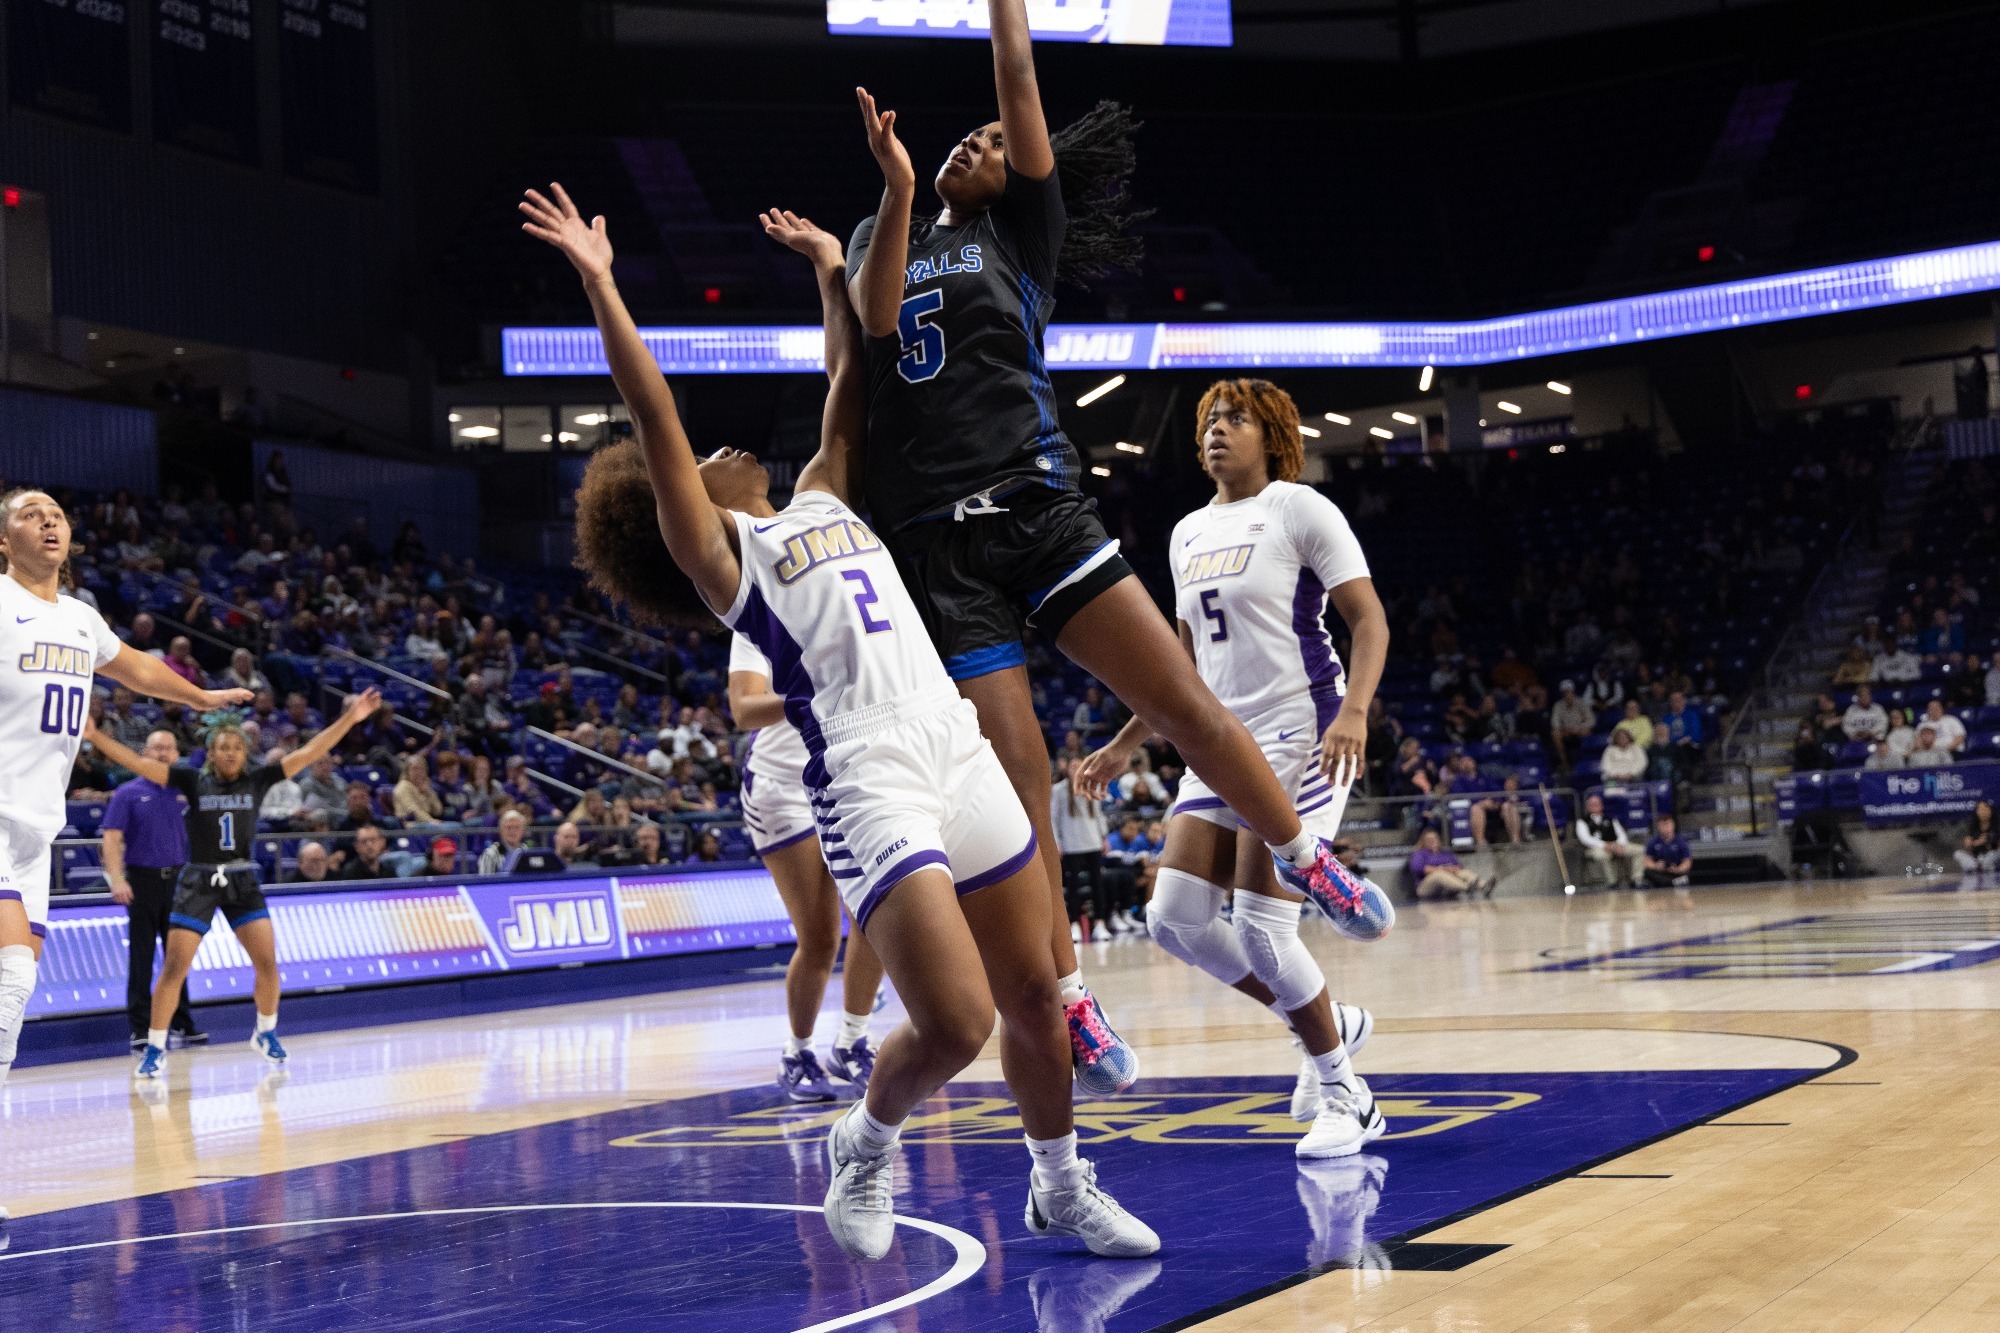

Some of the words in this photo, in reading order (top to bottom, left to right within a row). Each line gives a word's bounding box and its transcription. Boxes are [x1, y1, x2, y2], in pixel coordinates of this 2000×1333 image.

[905, 244, 983, 289] YALS
[896, 288, 946, 384] 5
[1044, 332, 1135, 362] JMU
[772, 518, 882, 587] JMU
[1180, 543, 1256, 589] JMU
[841, 569, 893, 636] 2
[1200, 588, 1228, 643] 5
[18, 641, 90, 678] JMU
[40, 683, 84, 737] 00
[219, 811, 236, 851] 1
[875, 836, 909, 866] DUKES
[502, 895, 612, 953] JMU
